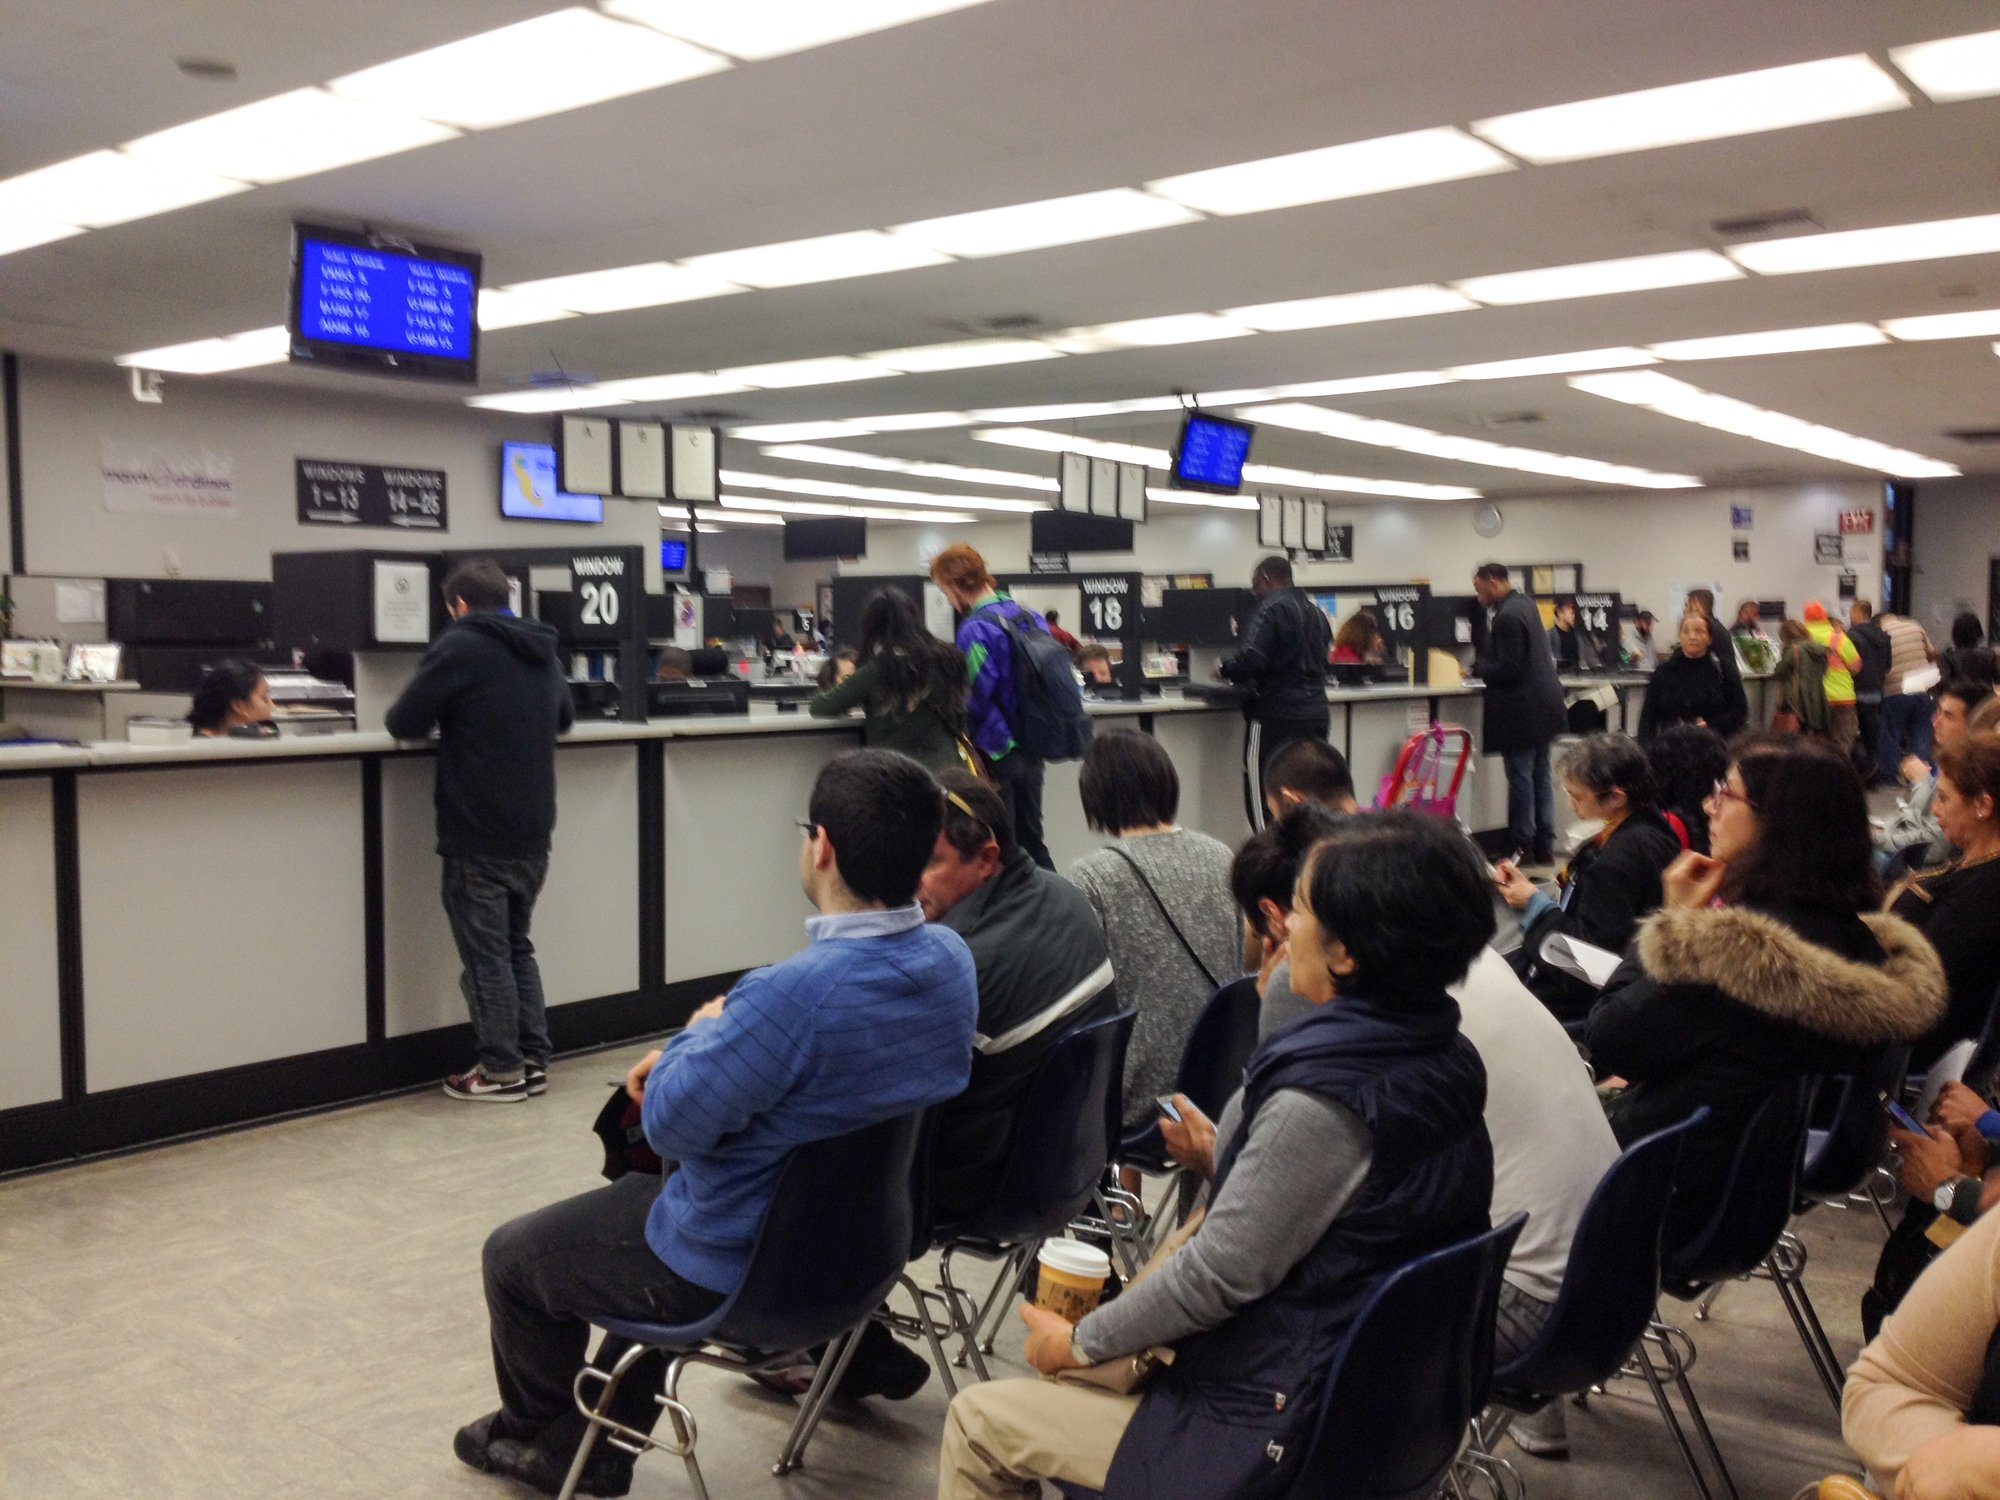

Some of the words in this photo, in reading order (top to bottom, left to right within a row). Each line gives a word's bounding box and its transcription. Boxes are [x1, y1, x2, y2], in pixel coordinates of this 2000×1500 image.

[302, 463, 366, 484] WINDOWS
[382, 468, 442, 490] WINDOWS
[572, 556, 624, 576] WINDOW
[1082, 577, 1129, 595] WINDOW
[1378, 587, 1420, 603] WINDOW
[580, 581, 619, 625] 20
[1575, 594, 1613, 608] WINDOW
[1089, 596, 1122, 630] 18
[1383, 603, 1415, 631] 16
[1580, 607, 1608, 632] 14
